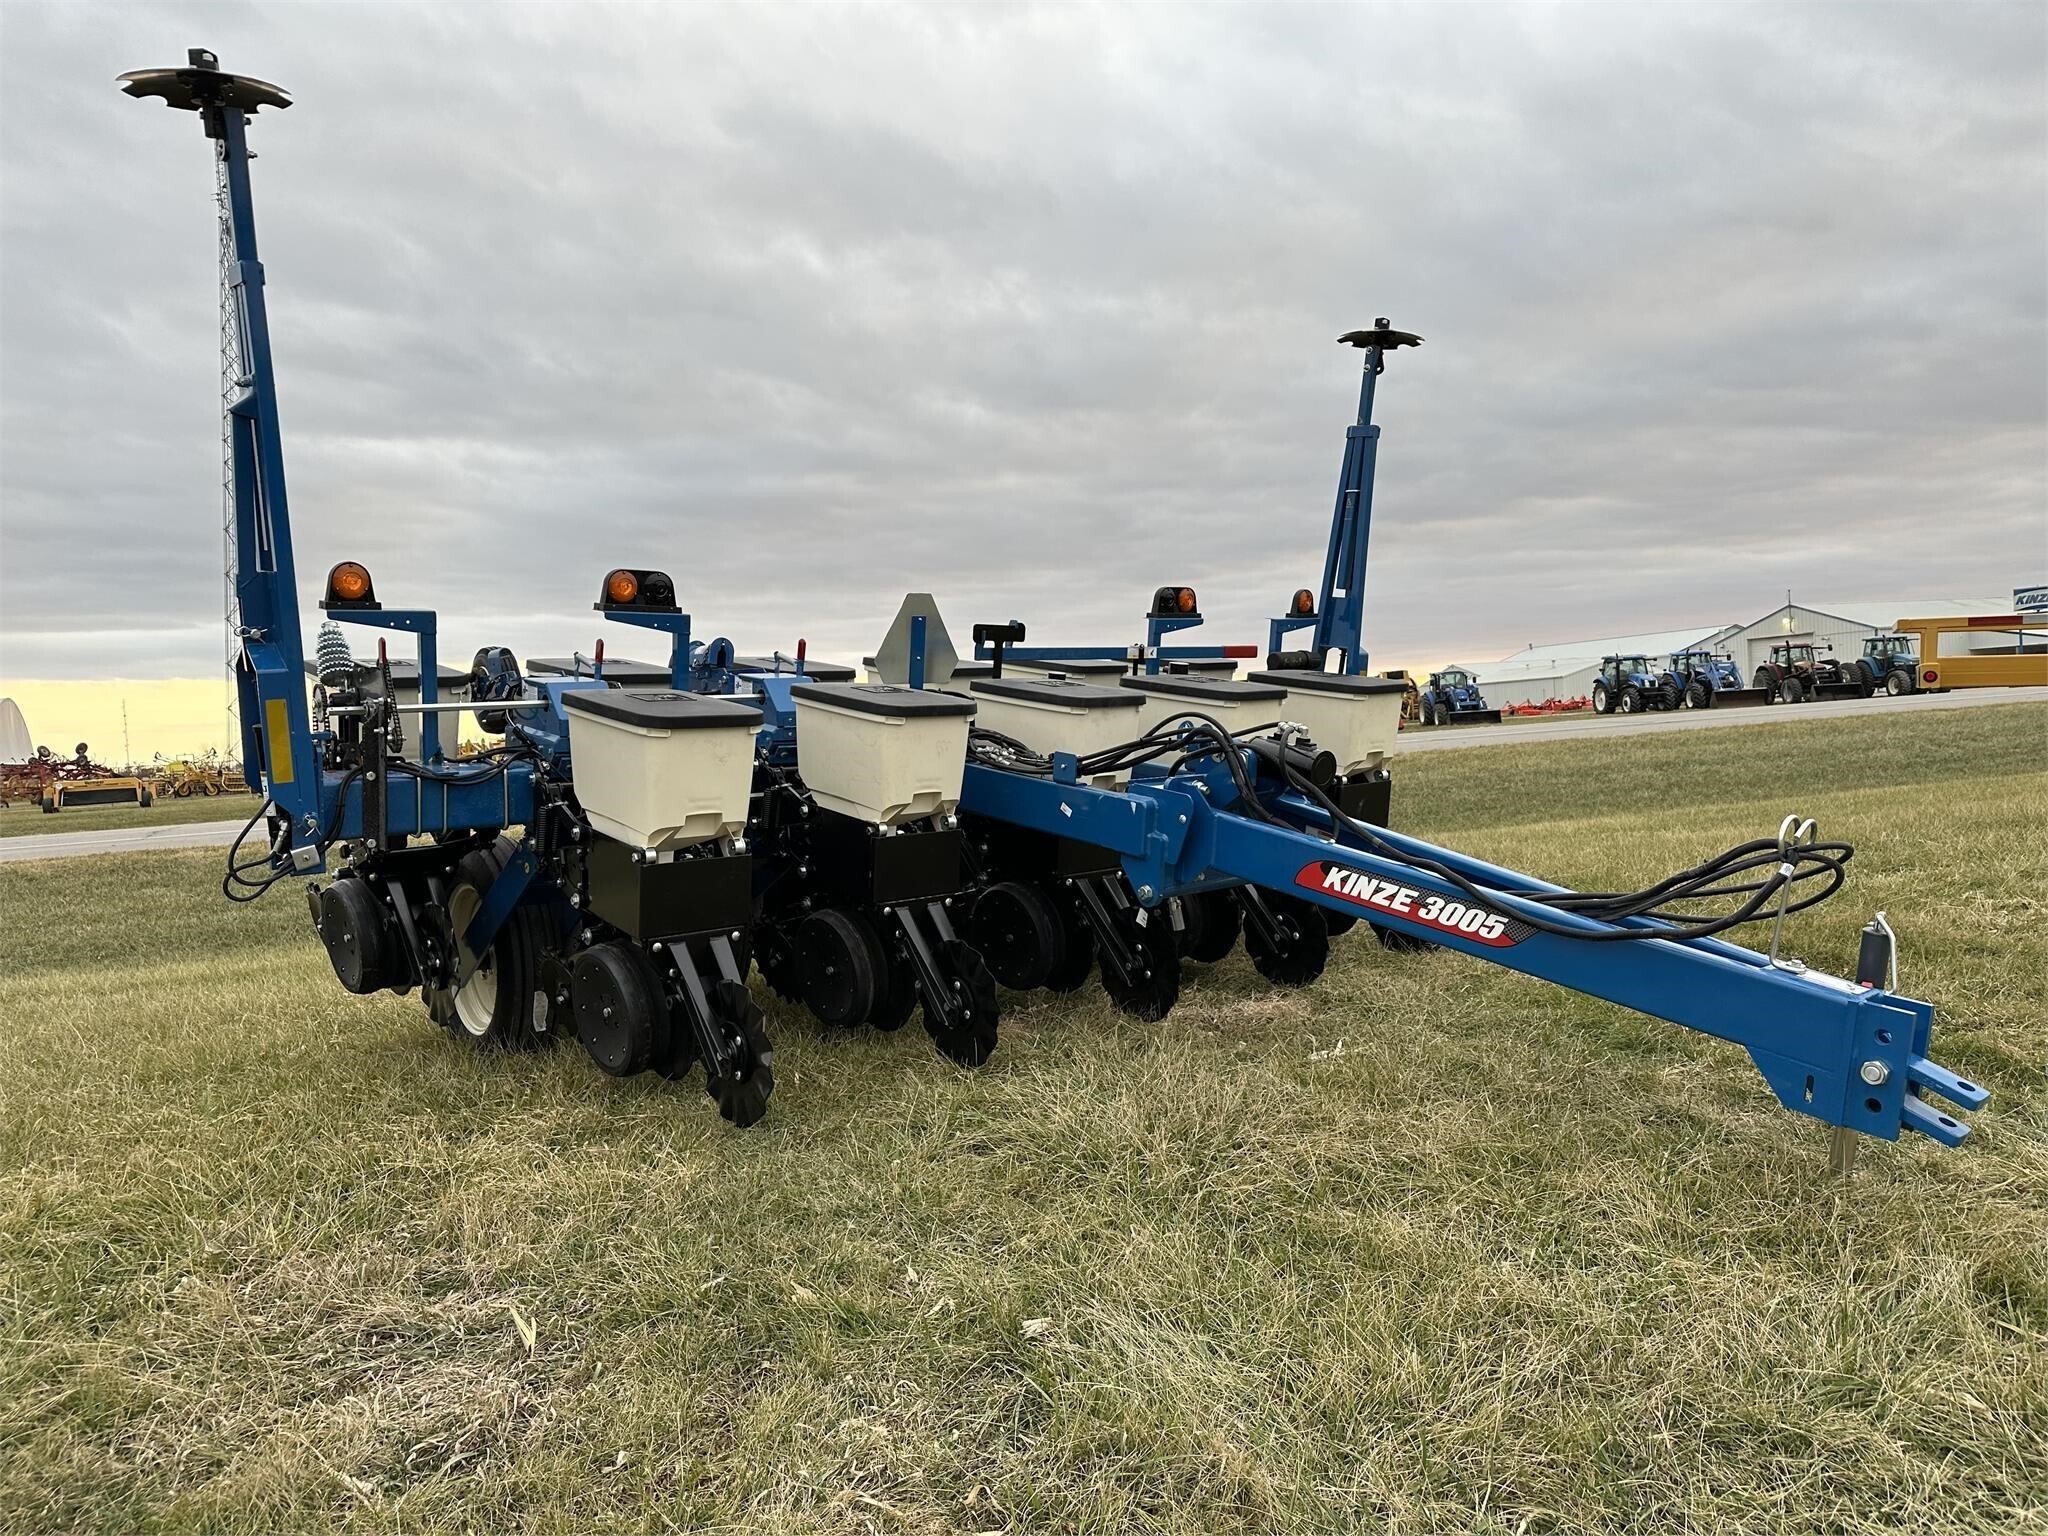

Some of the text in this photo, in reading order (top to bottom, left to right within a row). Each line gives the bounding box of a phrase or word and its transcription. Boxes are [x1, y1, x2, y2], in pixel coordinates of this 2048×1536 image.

[2015, 593, 2048, 605] KINZ
[1322, 866, 1509, 939] KINZE 3005
